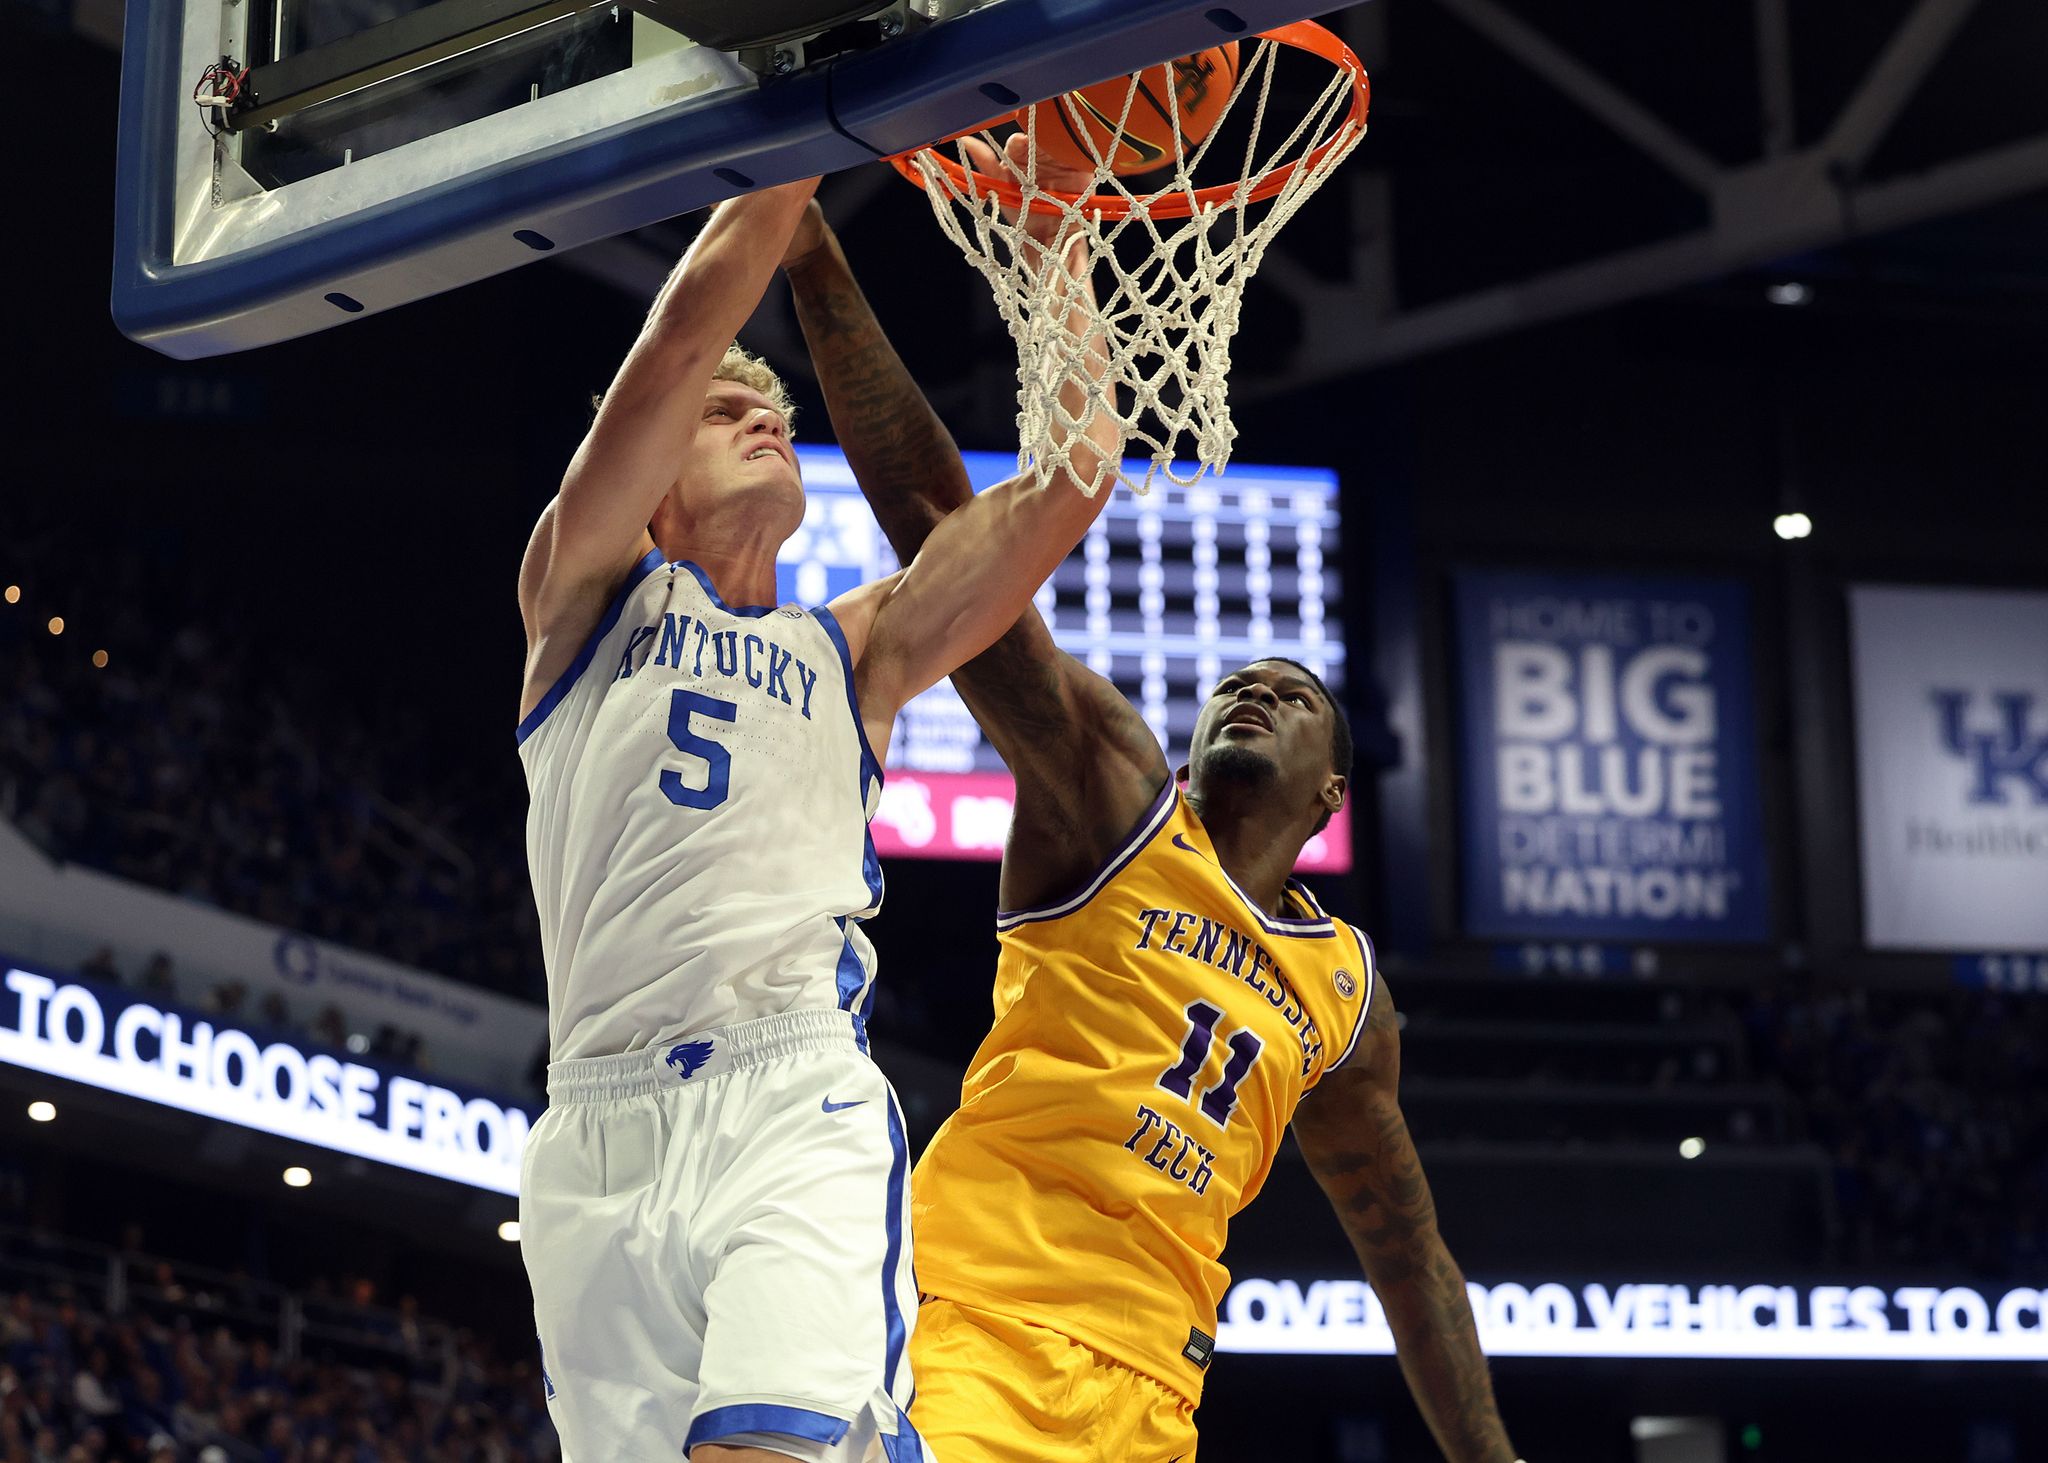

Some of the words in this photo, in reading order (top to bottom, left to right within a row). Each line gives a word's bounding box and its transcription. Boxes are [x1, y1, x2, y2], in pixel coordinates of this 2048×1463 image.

[612, 612, 817, 721] KNTUCKY
[1490, 597, 1638, 644] HOME
[1651, 601, 1716, 646] TO
[1494, 642, 1717, 746] BIG
[658, 688, 738, 811] 5
[1498, 744, 1721, 819] BLUE
[1502, 866, 1730, 920] NATION
[5, 968, 104, 1057] TO
[114, 1002, 379, 1123] CHOOSE
[1154, 998, 1266, 1132] 11
[1123, 1104, 1217, 1197] TECH
[1582, 1283, 1890, 1336] VEHICLES
[1893, 1286, 1990, 1336] TO
